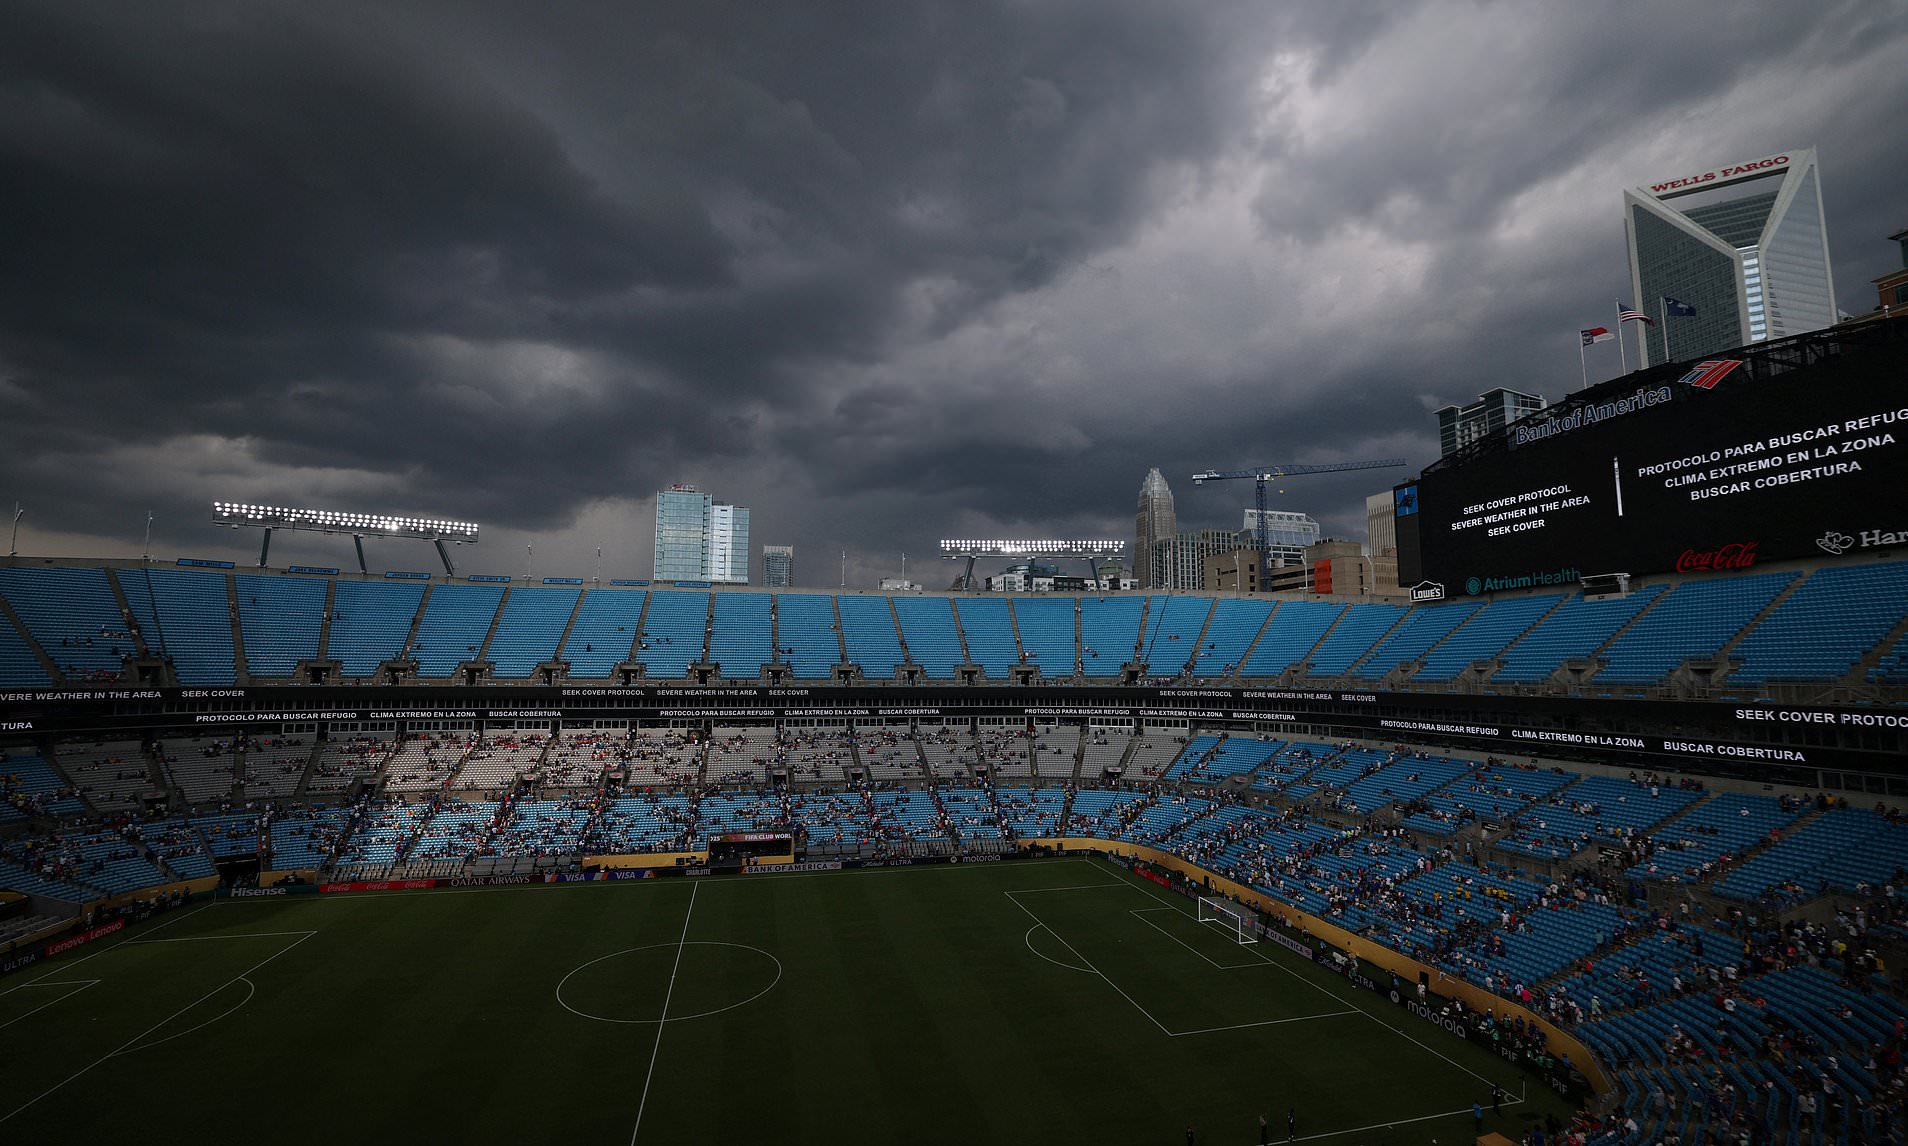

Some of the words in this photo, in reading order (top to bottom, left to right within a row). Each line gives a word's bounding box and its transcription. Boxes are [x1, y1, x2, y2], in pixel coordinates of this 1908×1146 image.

[1651, 172, 1716, 192] WELLS
[1721, 156, 1790, 177] FARGO
[1516, 417, 1562, 445] Bank
[1562, 408, 1583, 431] of
[1583, 386, 1672, 425] America
[1639, 451, 1720, 477] PROTOCOLO
[1725, 441, 1765, 458] PARA
[1769, 424, 1840, 449] BUSCAR
[1845, 408, 1908, 432] REFUG
[1665, 472, 1706, 487] CLIMA
[1710, 456, 1782, 479] EXTREMO
[1787, 451, 1809, 464] EN
[1814, 445, 1837, 458] LA
[1841, 433, 1895, 453] ZONA
[1690, 480, 1750, 500] BUSCAR
[1754, 460, 1862, 489] COBERTURA
[1464, 503, 1484, 515] SEEK
[1487, 496, 1516, 510] COVER
[1519, 484, 1571, 503] PROTOCOL
[1452, 517, 1482, 531] SEVERE
[1484, 508, 1526, 524] WEATHER
[1529, 505, 1537, 515] IN
[1540, 501, 1559, 513] THE
[1562, 495, 1590, 509] AREA
[1488, 525, 1510, 537] SEEK
[1513, 519, 1544, 532] COVER
[1676, 540, 1759, 573] Coca-Cola
[1483, 574, 1532, 592] Atrium
[1533, 567, 1581, 586] Health
[1412, 587, 1441, 600] LOWE'S
[36, 692, 91, 700] WEATHER
[1, 722, 32, 730] TURA
[1736, 710, 1775, 720] SEEK
[1780, 712, 1835, 724] COVER
[1381, 720, 1417, 728] PROTOCOLO
[1419, 722, 1435, 730] PARA
[1437, 724, 1464, 732] BUSCAR
[1466, 726, 1498, 736] REFUGIO
[1512, 730, 1537, 738] CLIMA
[1539, 732, 1582, 742] EXTREMO
[1585, 736, 1597, 744] EN
[1600, 736, 1613, 746] LA
[1615, 738, 1644, 748] ZONA
[1664, 742, 1714, 754] BUSCAR
[1718, 746, 1805, 762] COBERTURA
[786, 863, 828, 871] AMERICA
[963, 854, 1000, 862] motorola
[451, 878, 486, 887] QATAR
[489, 876, 531, 885] AIRWAYS
[565, 873, 585, 881] VISA
[616, 871, 636, 879] VISA
[230, 886, 287, 897] Hisense
[90, 922, 122, 941] Lenovo
[49, 935, 85, 955] Lenovo
[3, 953, 36, 972] ULTRA
[1407, 1000, 1466, 1040] motorola
[1501, 1047, 1520, 1062] PIF
[1552, 1077, 1568, 1095] PIF
